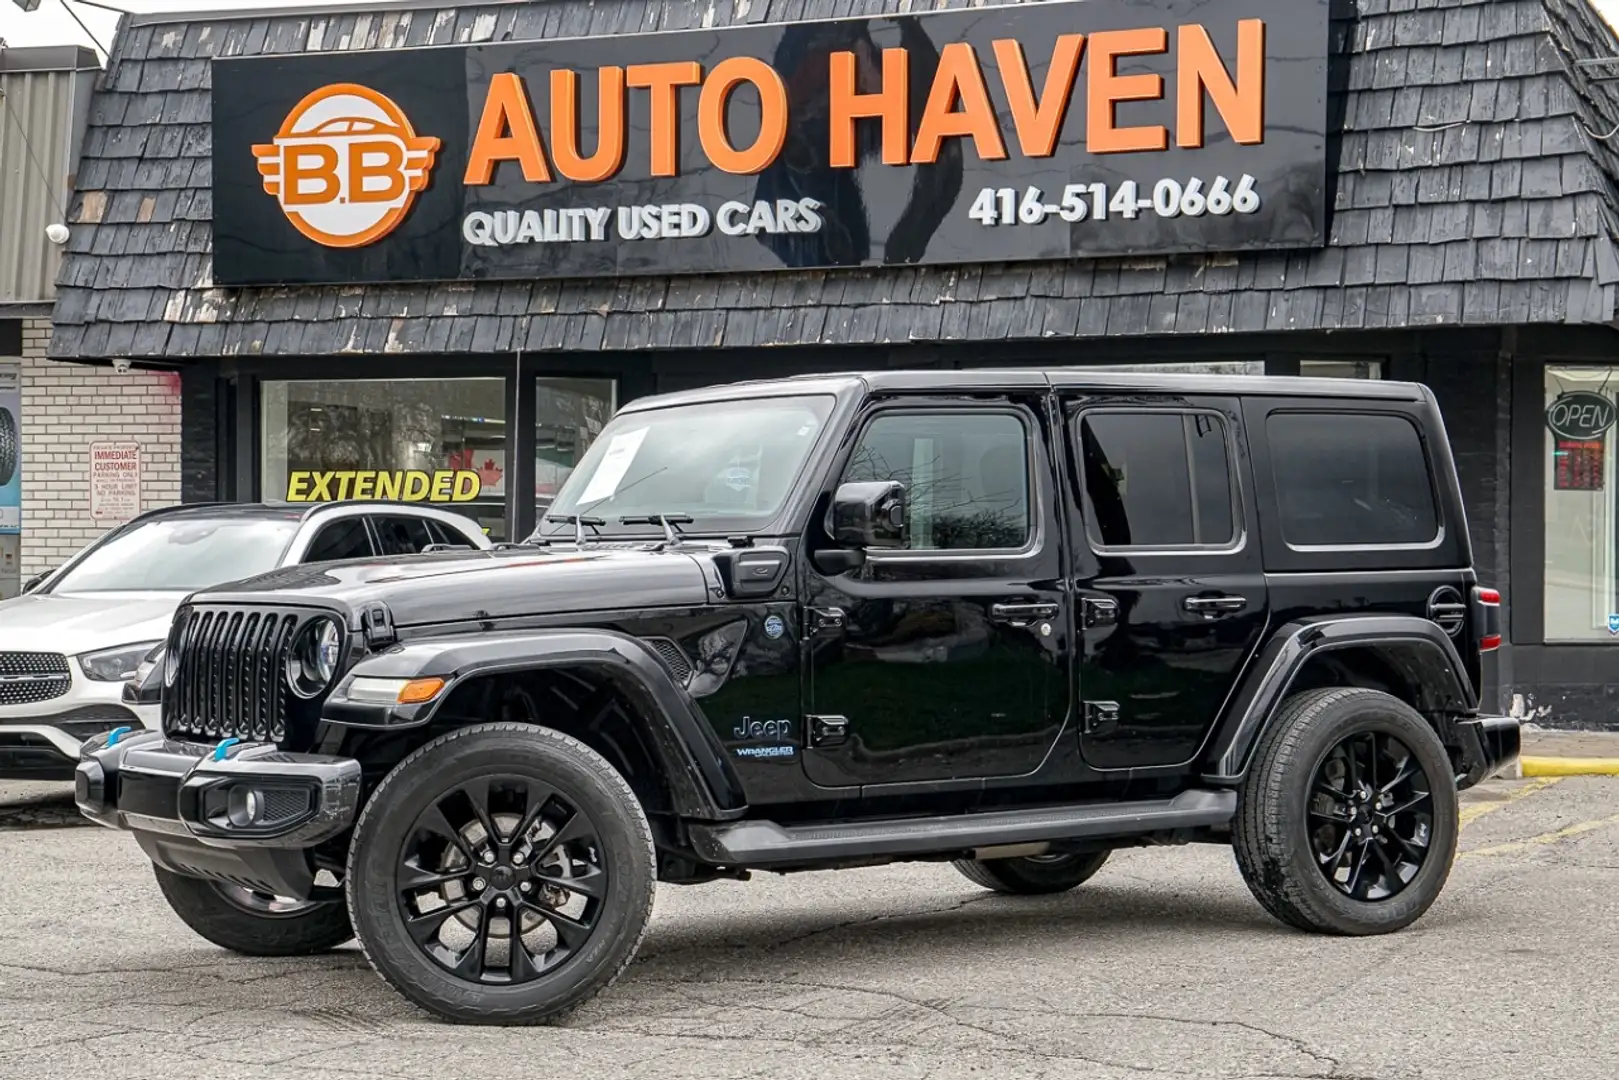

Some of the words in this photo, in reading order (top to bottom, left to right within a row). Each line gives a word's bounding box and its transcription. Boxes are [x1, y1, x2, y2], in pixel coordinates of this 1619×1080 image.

[463, 56, 788, 185] AUTO
[829, 18, 1266, 168] HAVEN
[969, 174, 1261, 226] 416-514-0666
[463, 205, 612, 246] QUALITY
[617, 202, 711, 240] USED
[717, 197, 824, 236] CARS
[1552, 404, 1610, 427] OPEN
[94, 450, 138, 460] IMMEDIATE
[94, 462, 137, 471] CUSTOMER
[286, 469, 482, 502] EXTENDED
[733, 716, 792, 741] Jeep
